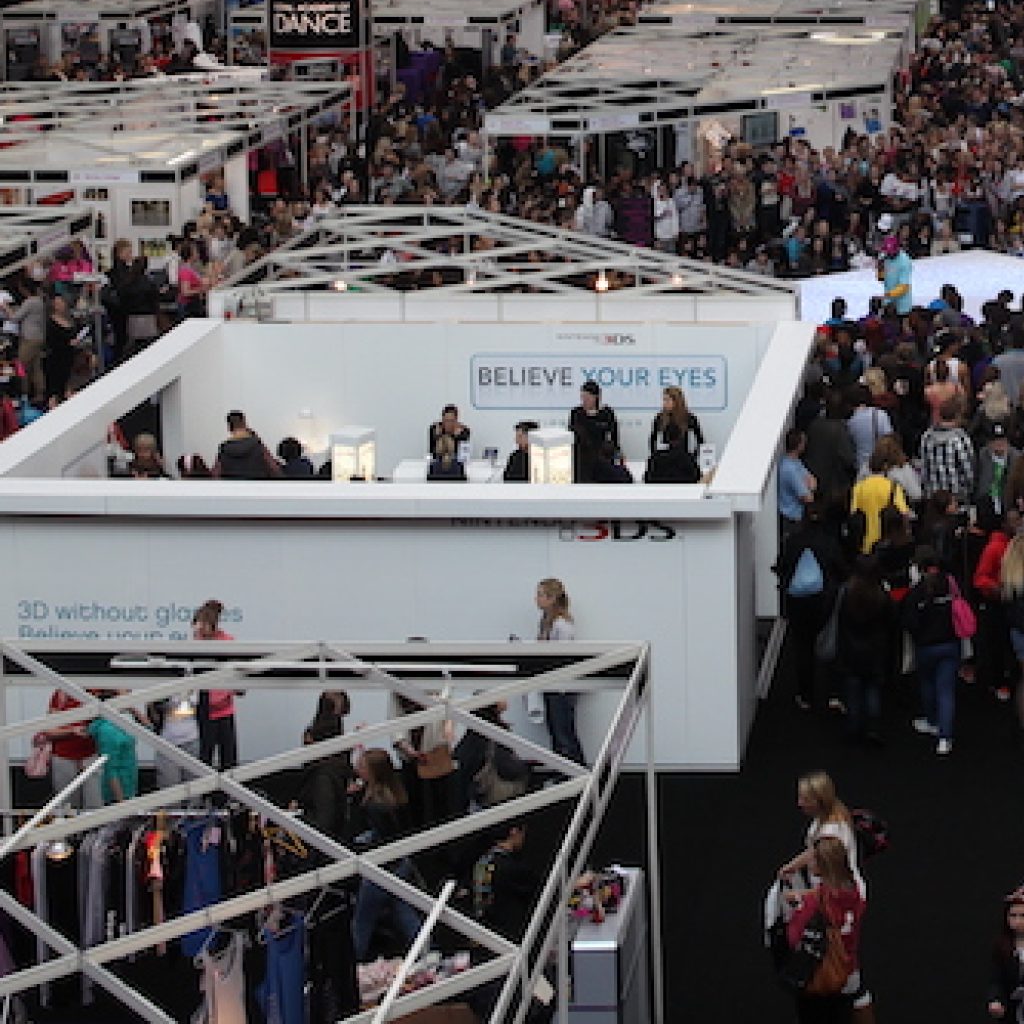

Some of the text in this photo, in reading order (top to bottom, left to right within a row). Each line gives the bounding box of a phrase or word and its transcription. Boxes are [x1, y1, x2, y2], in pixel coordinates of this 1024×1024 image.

[273, 13, 351, 33] DANCE
[478, 367, 717, 386] BELIEVE YOUR EYES
[18, 599, 244, 628] 3D without glaes
